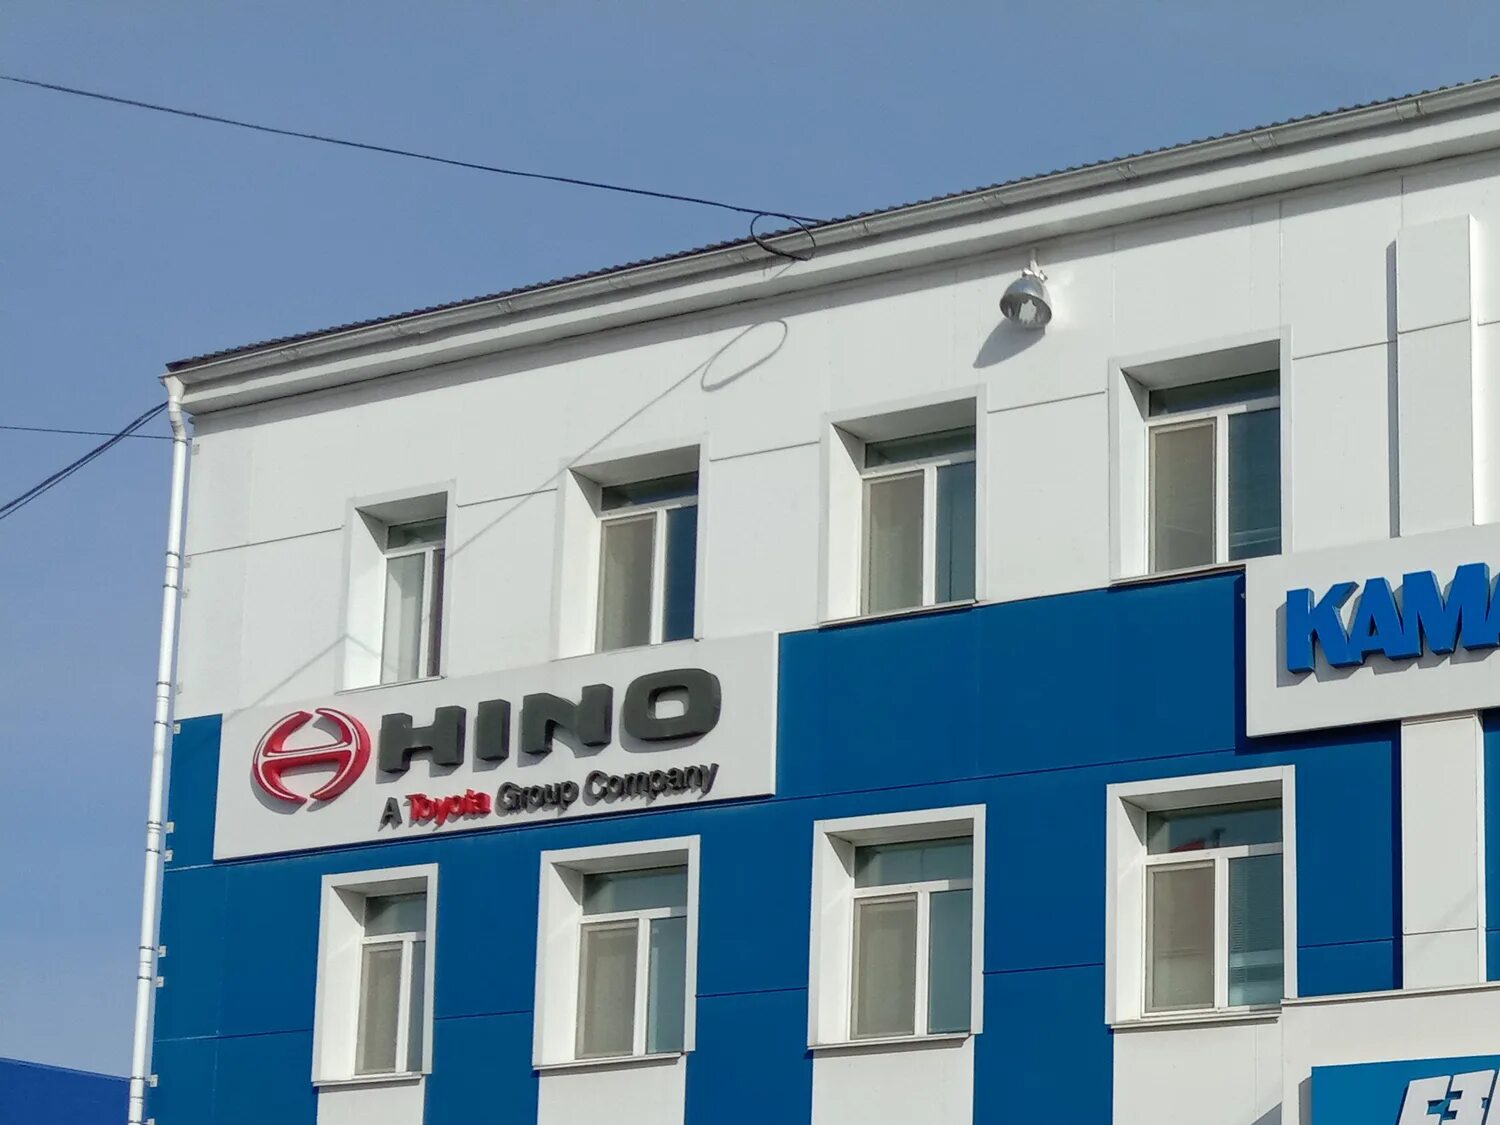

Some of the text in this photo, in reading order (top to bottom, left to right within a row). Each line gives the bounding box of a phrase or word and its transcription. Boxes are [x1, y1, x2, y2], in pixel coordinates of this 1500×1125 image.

[379, 668, 722, 774] HINO
[382, 763, 720, 830] A Toyota Group Company
